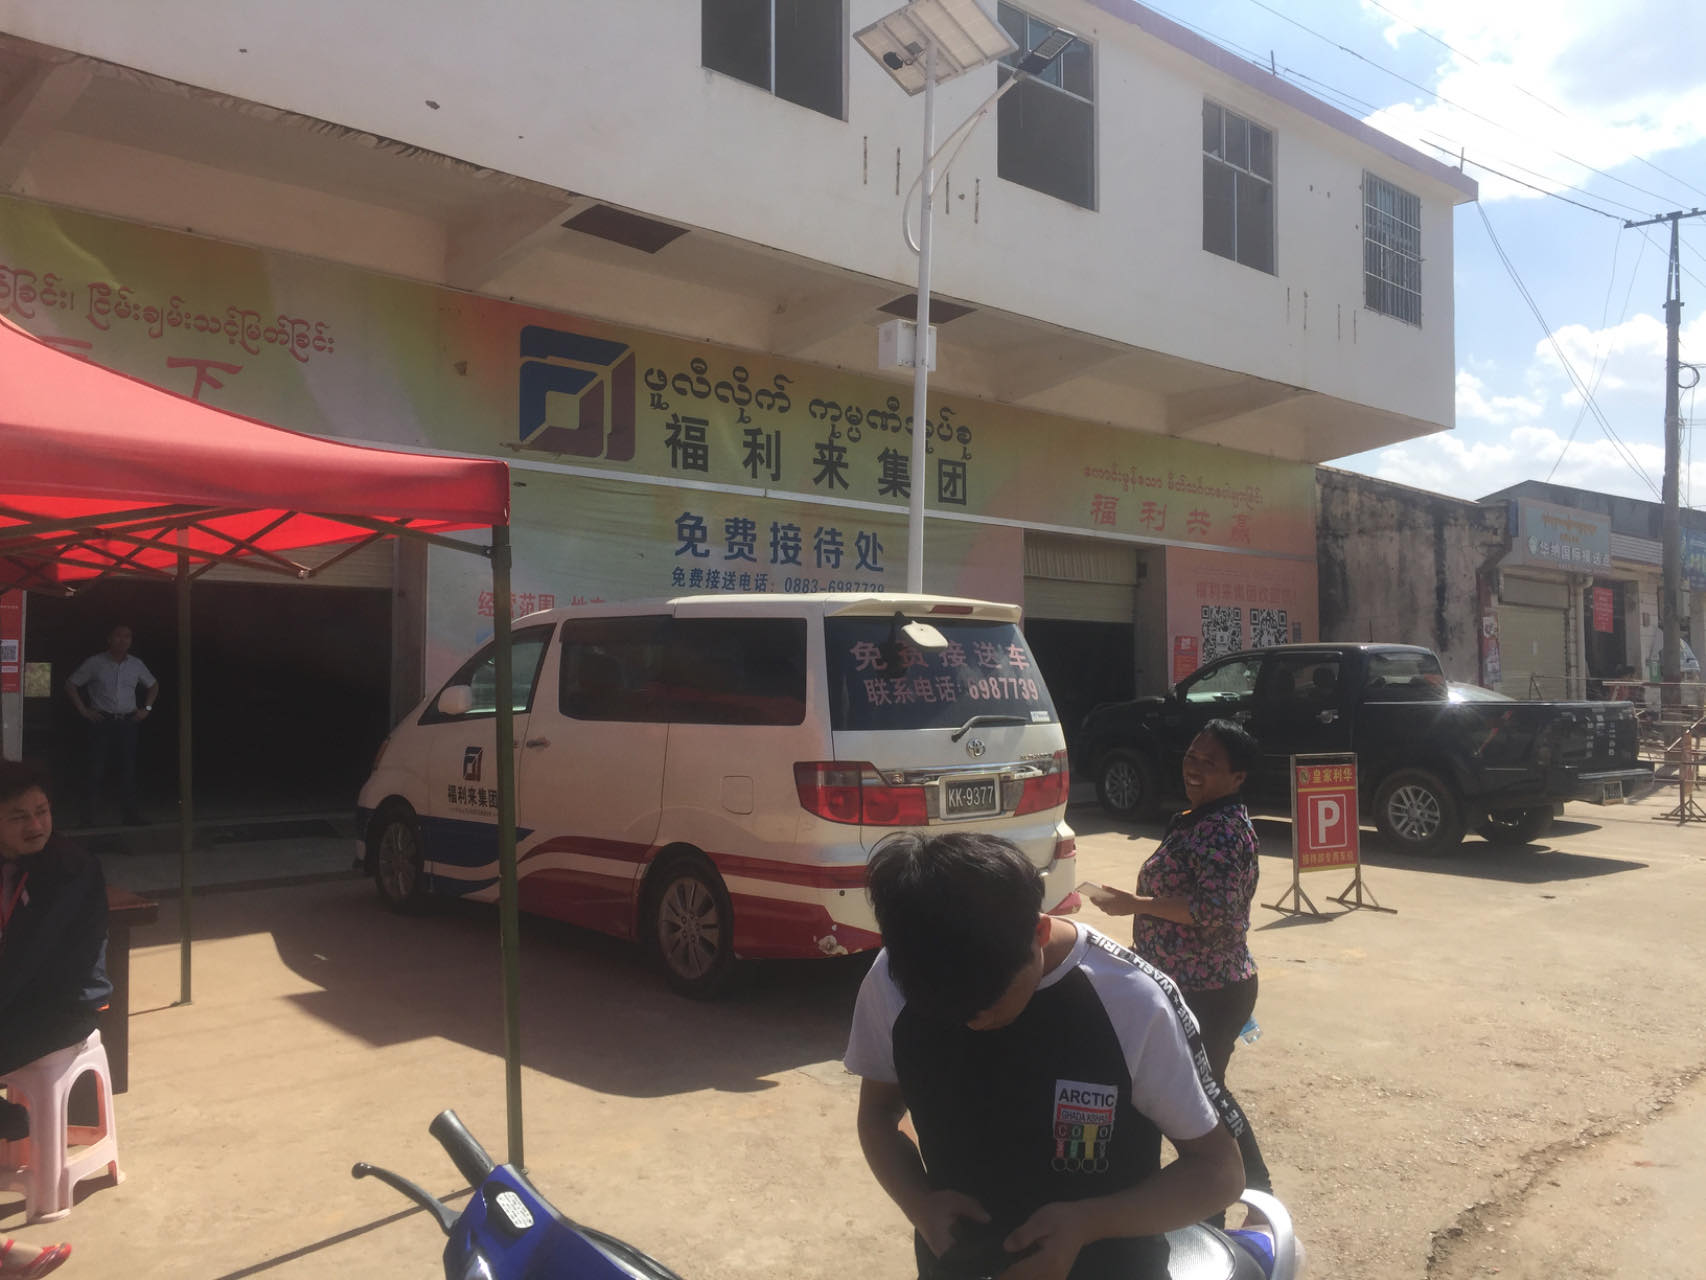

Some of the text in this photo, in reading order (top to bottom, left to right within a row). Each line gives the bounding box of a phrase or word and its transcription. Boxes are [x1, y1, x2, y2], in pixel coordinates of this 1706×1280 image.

[664, 412, 968, 505] 福利来集团
[674, 511, 885, 572] 免费接待处
[851, 640, 1031, 671] 免费接送车
[948, 786, 994, 807] KK-9377
[1317, 800, 1341, 844] P
[1058, 1087, 1115, 1107] ARCTIC
